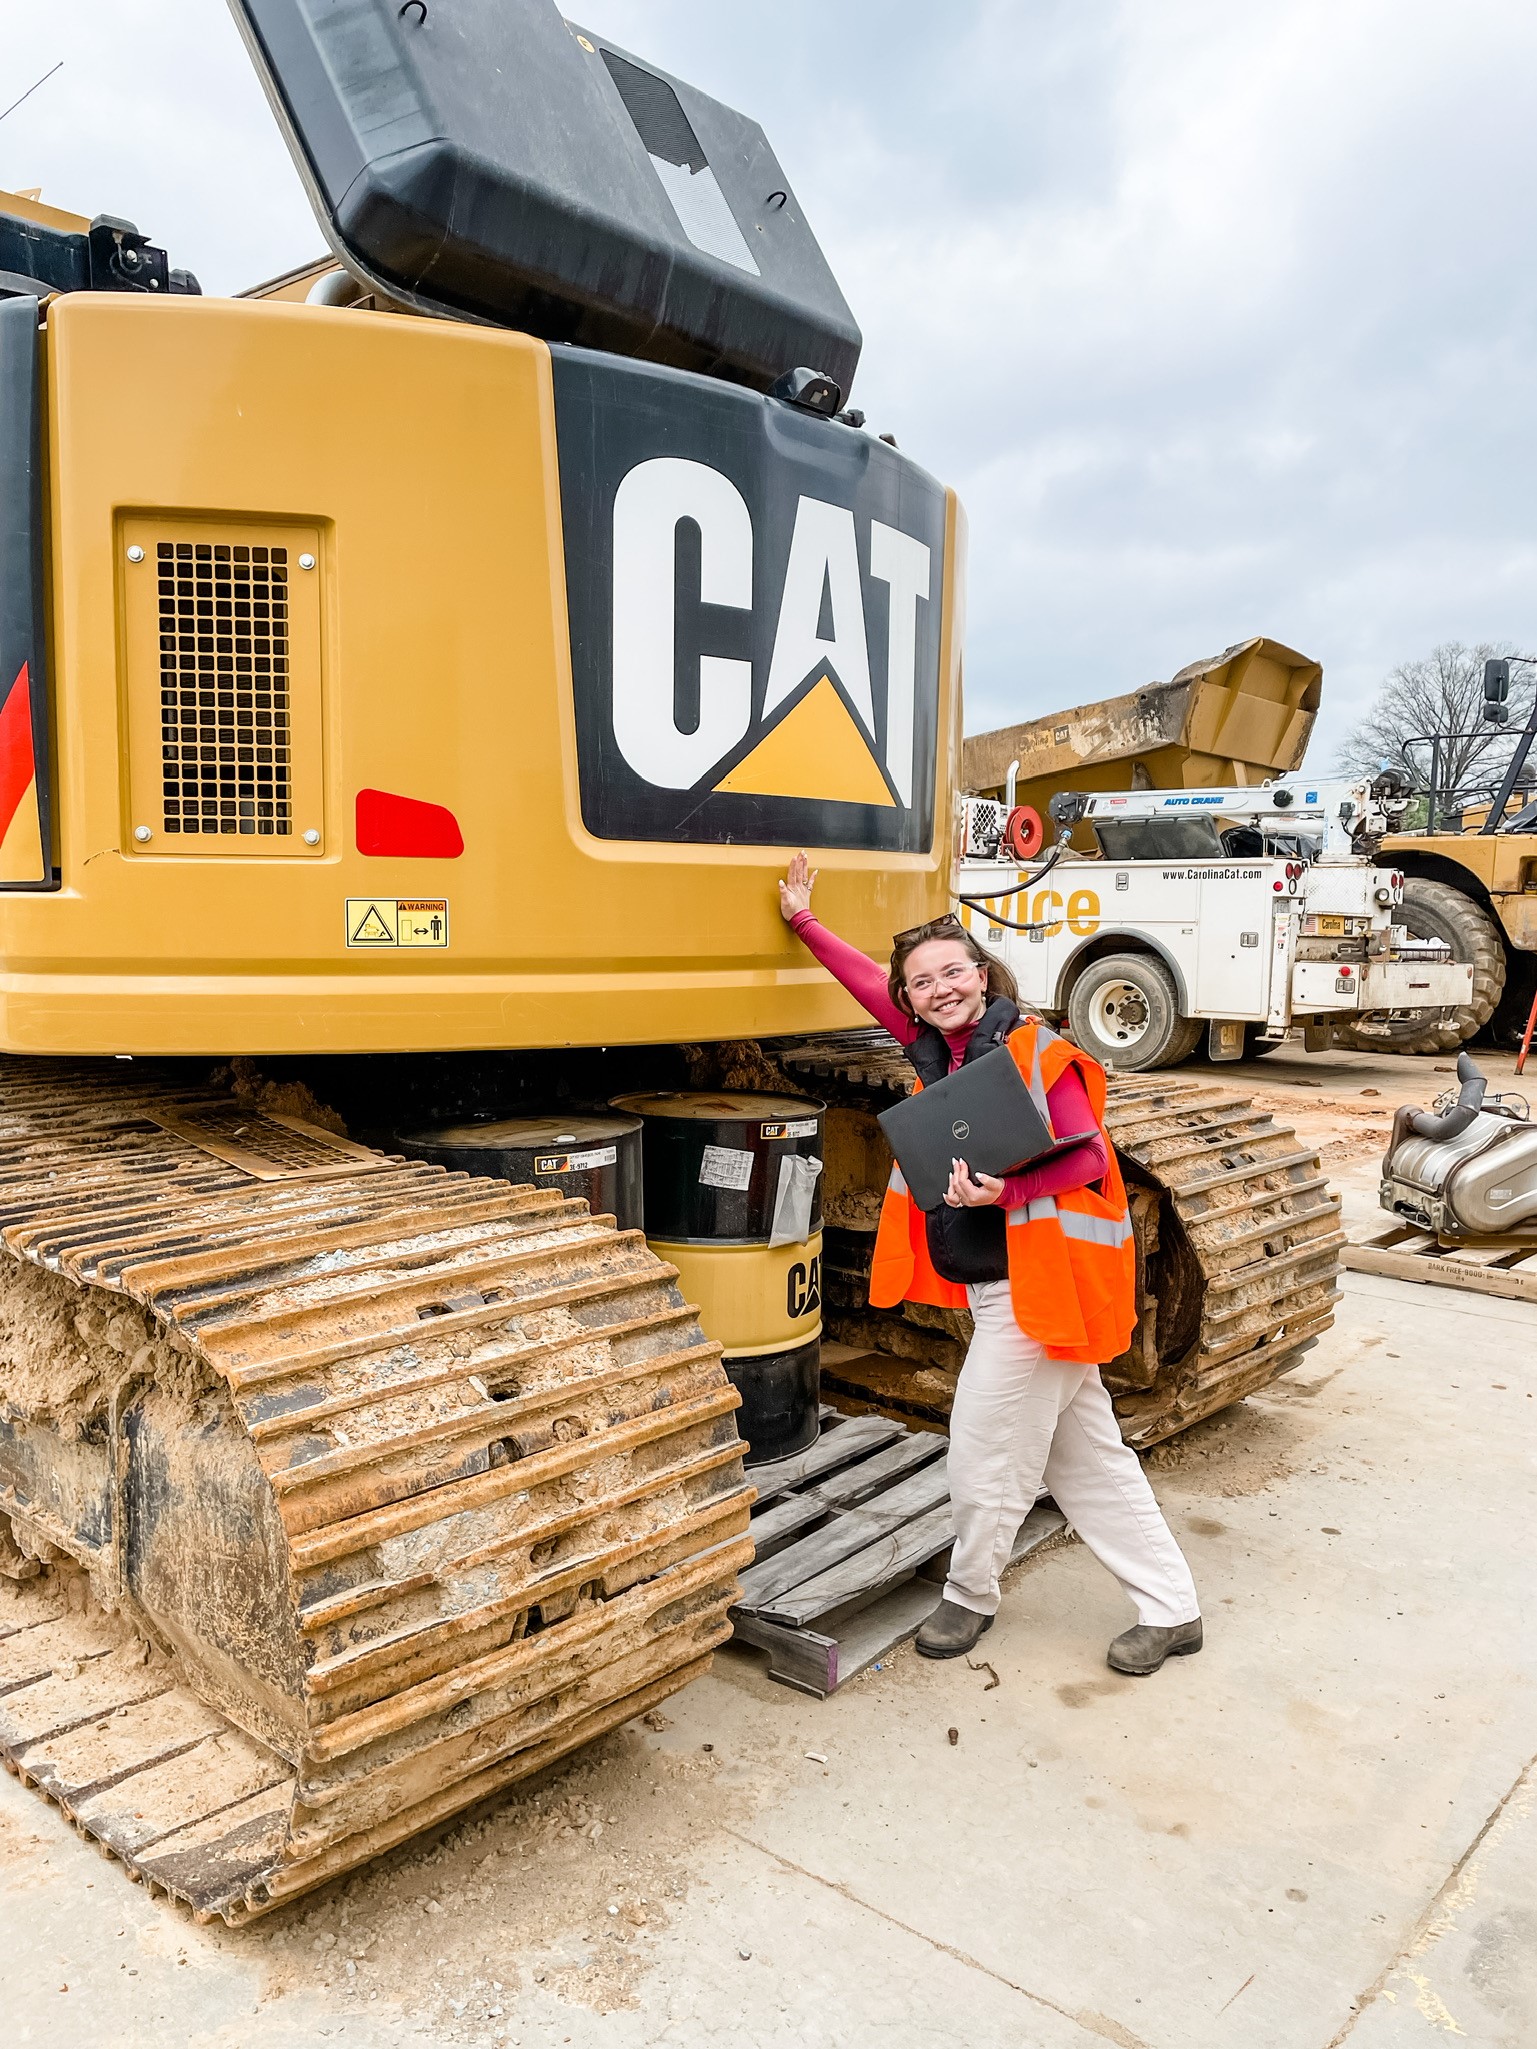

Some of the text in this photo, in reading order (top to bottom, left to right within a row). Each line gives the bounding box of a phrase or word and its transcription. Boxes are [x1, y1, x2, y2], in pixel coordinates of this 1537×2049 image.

[612, 456, 931, 810] CAT
[1055, 729, 1068, 741] CAT
[1163, 796, 1225, 806] AUTO CRANE
[1162, 868, 1262, 880] www.CarolinaCat.com
[407, 903, 444, 911] WARNING
[1321, 918, 1341, 930] Carolina
[765, 1126, 780, 1136] CAT
[541, 1158, 559, 1171] CAT
[569, 1162, 588, 1171] 3E-9712
